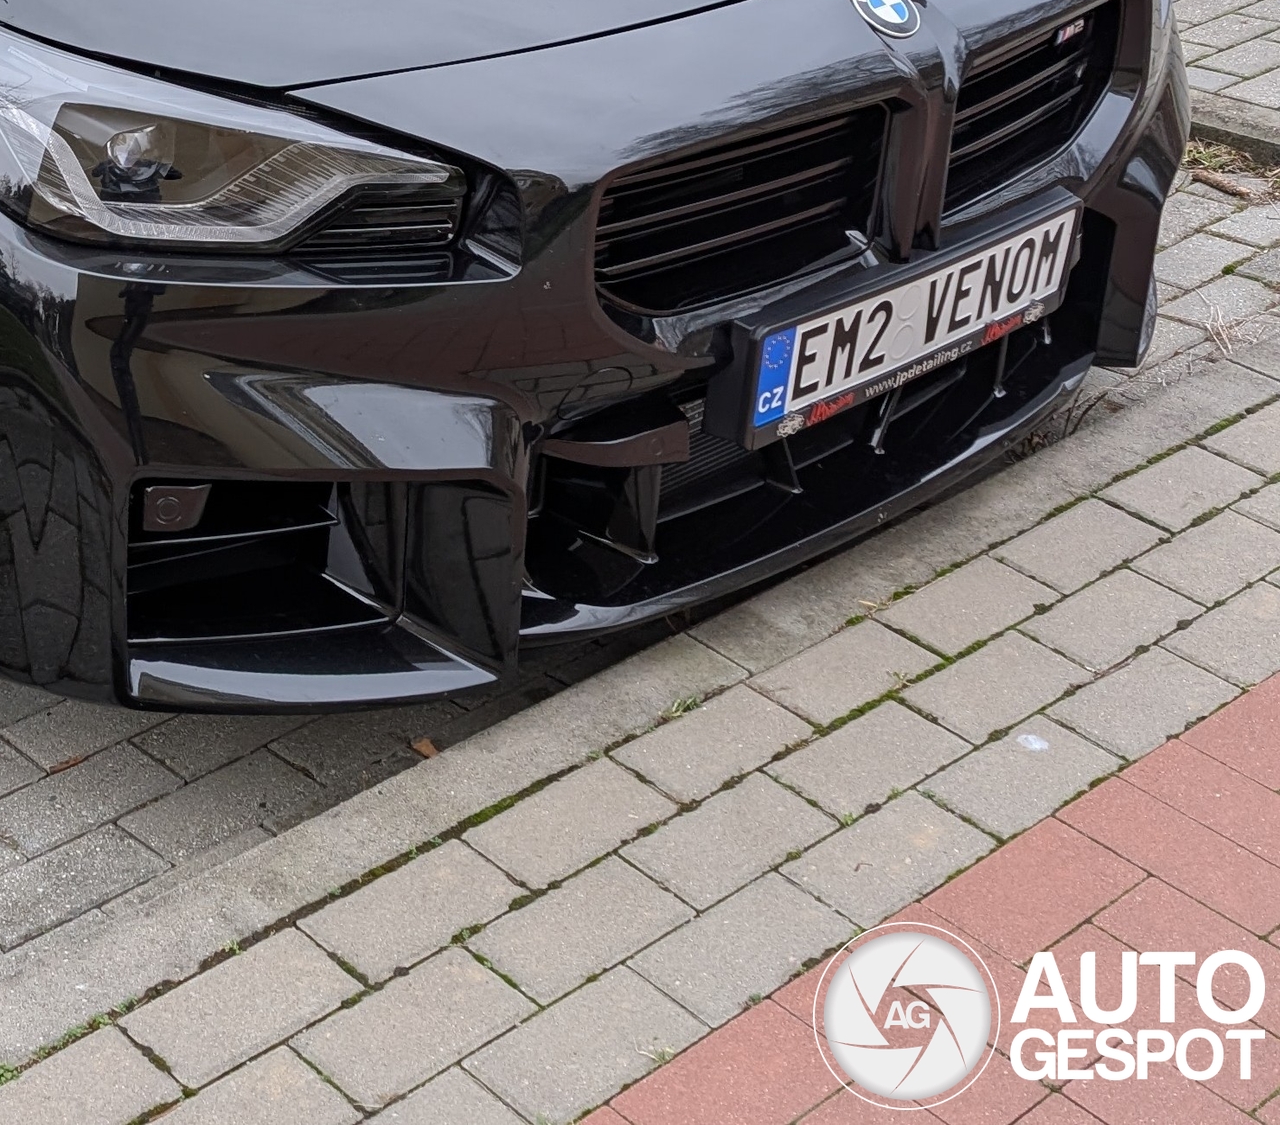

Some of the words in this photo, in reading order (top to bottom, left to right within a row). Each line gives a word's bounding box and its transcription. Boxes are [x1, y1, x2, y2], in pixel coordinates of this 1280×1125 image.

[791, 300, 893, 403] EM2
[923, 220, 1067, 345] VENOM
[864, 340, 973, 398] www.jpdetailing.cz
[757, 385, 784, 414] CZ
